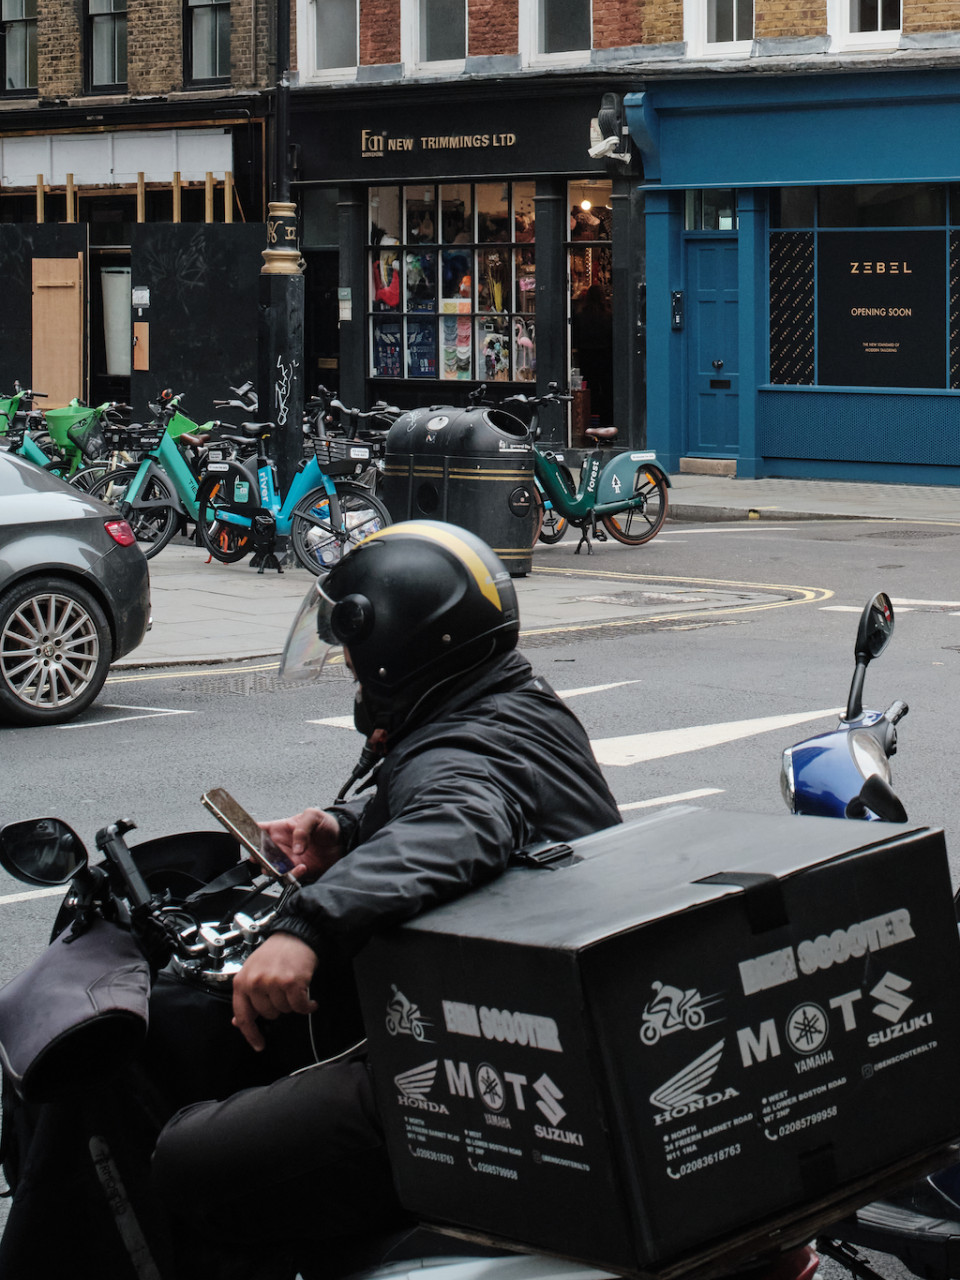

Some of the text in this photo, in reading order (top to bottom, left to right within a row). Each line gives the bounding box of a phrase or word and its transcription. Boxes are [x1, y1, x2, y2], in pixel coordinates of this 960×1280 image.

[388, 138, 414, 151] NEW
[421, 135, 490, 149] TRIMMINGS
[493, 133, 516, 146] LTD
[850, 262, 912, 273] ZEBEL
[851, 308, 912, 316] OPENING SOON
[259, 472, 269, 502] river
[587, 460, 600, 492] forest
[867, 1012, 933, 1048] SUZUKI
[794, 1050, 834, 1074] YAMAHA
[397, 1096, 449, 1115] HONDA
[653, 1087, 740, 1127] HONDA
[768, 1090, 788, 1103] WEST
[772, 1096, 797, 1111] LOWER
[798, 1085, 827, 1101] BOSTON
[828, 1077, 847, 1089] ROAD
[664, 1113, 753, 1152] 34 FRIERN BARNET ROAD
[671, 1125, 697, 1140] NORTH
[779, 1105, 838, 1136] 02085799958
[534, 1124, 584, 1146] SUZUKI
[680, 1143, 741, 1176] 02083618763
